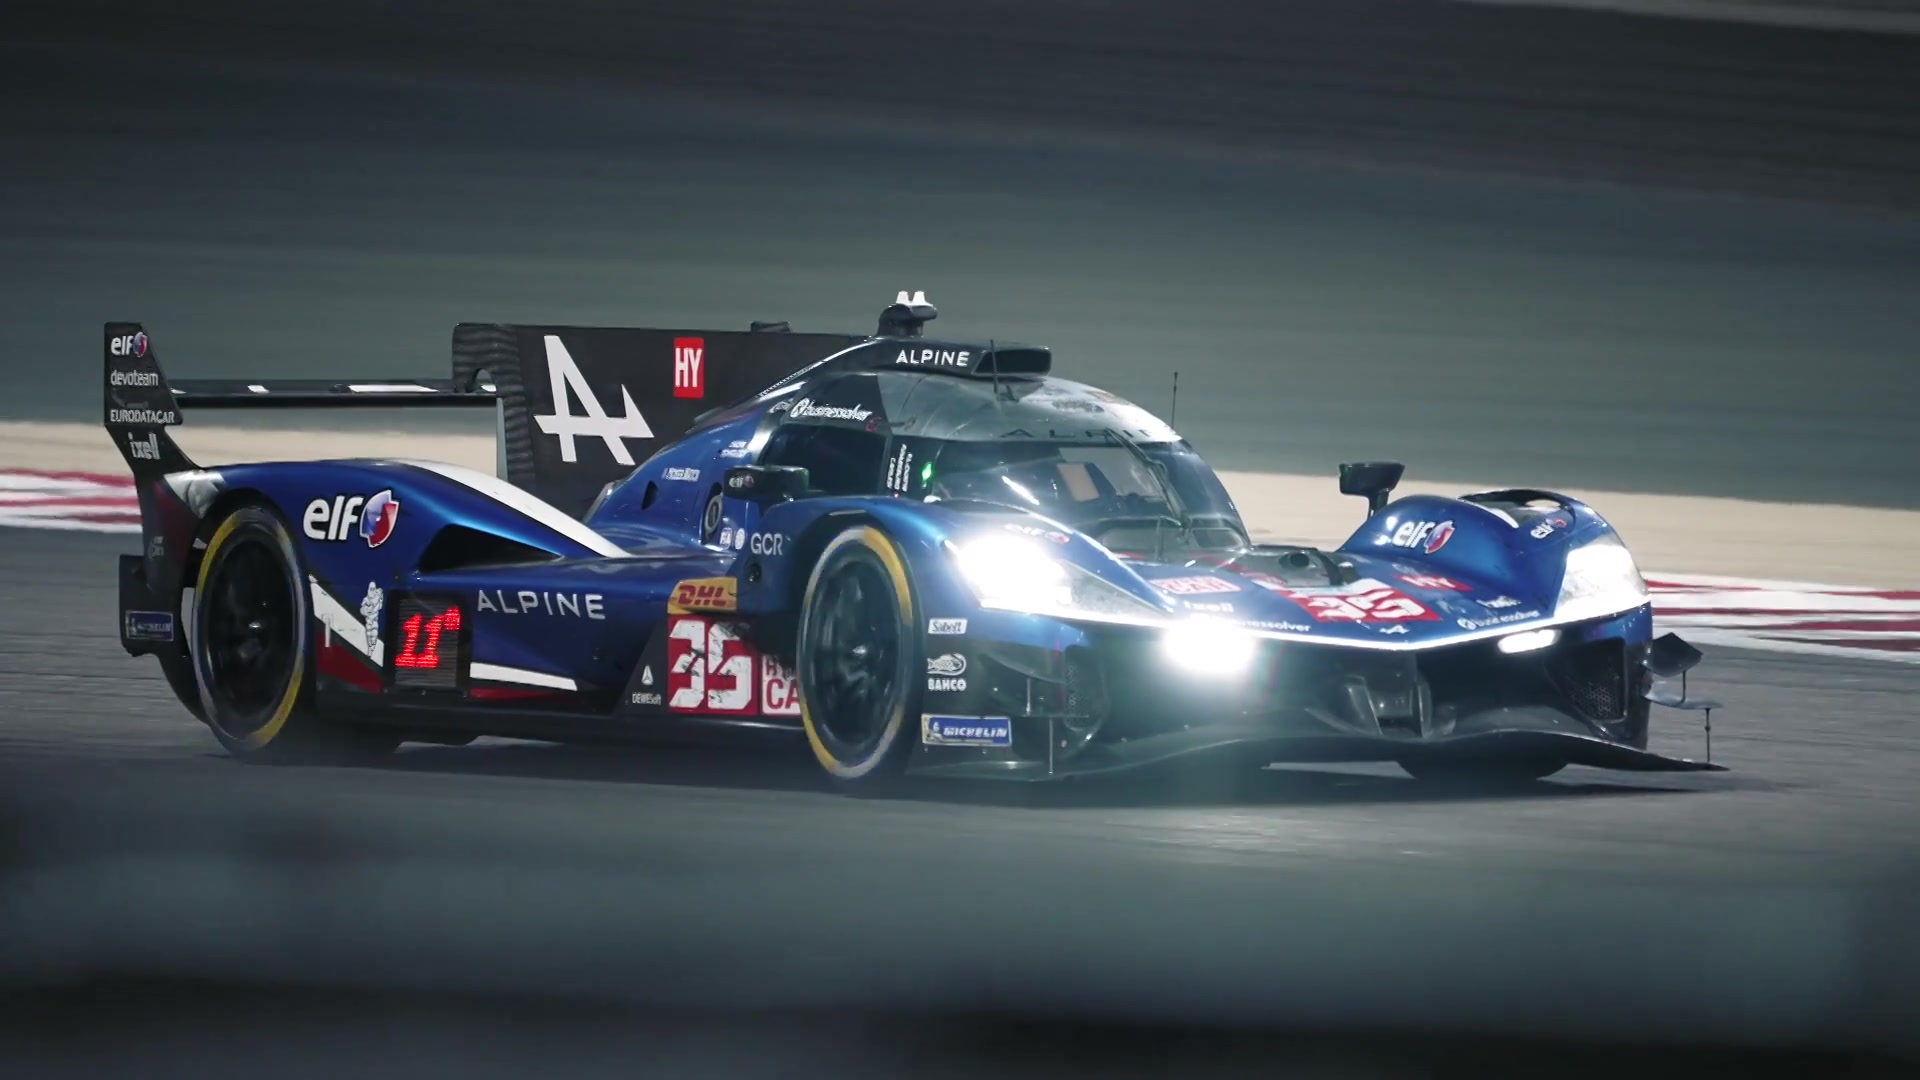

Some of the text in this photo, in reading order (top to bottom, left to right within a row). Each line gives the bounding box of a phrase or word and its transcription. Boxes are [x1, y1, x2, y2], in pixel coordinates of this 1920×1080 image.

[111, 335, 133, 355] elf
[675, 347, 702, 388] HY
[895, 349, 970, 367] ALPINE
[110, 370, 158, 386] devoteam
[110, 409, 175, 423] EURODATACAR
[128, 432, 160, 460] ixell
[303, 495, 364, 540] elf
[750, 532, 783, 555] GCR
[1392, 521, 1436, 549] elf
[477, 590, 605, 619] ALPINE
[678, 584, 727, 607] DHL
[669, 619, 752, 710] 35
[766, 678, 800, 710] CA
[927, 678, 967, 691] BAHCO
[943, 727, 1008, 738] MICHELIN
